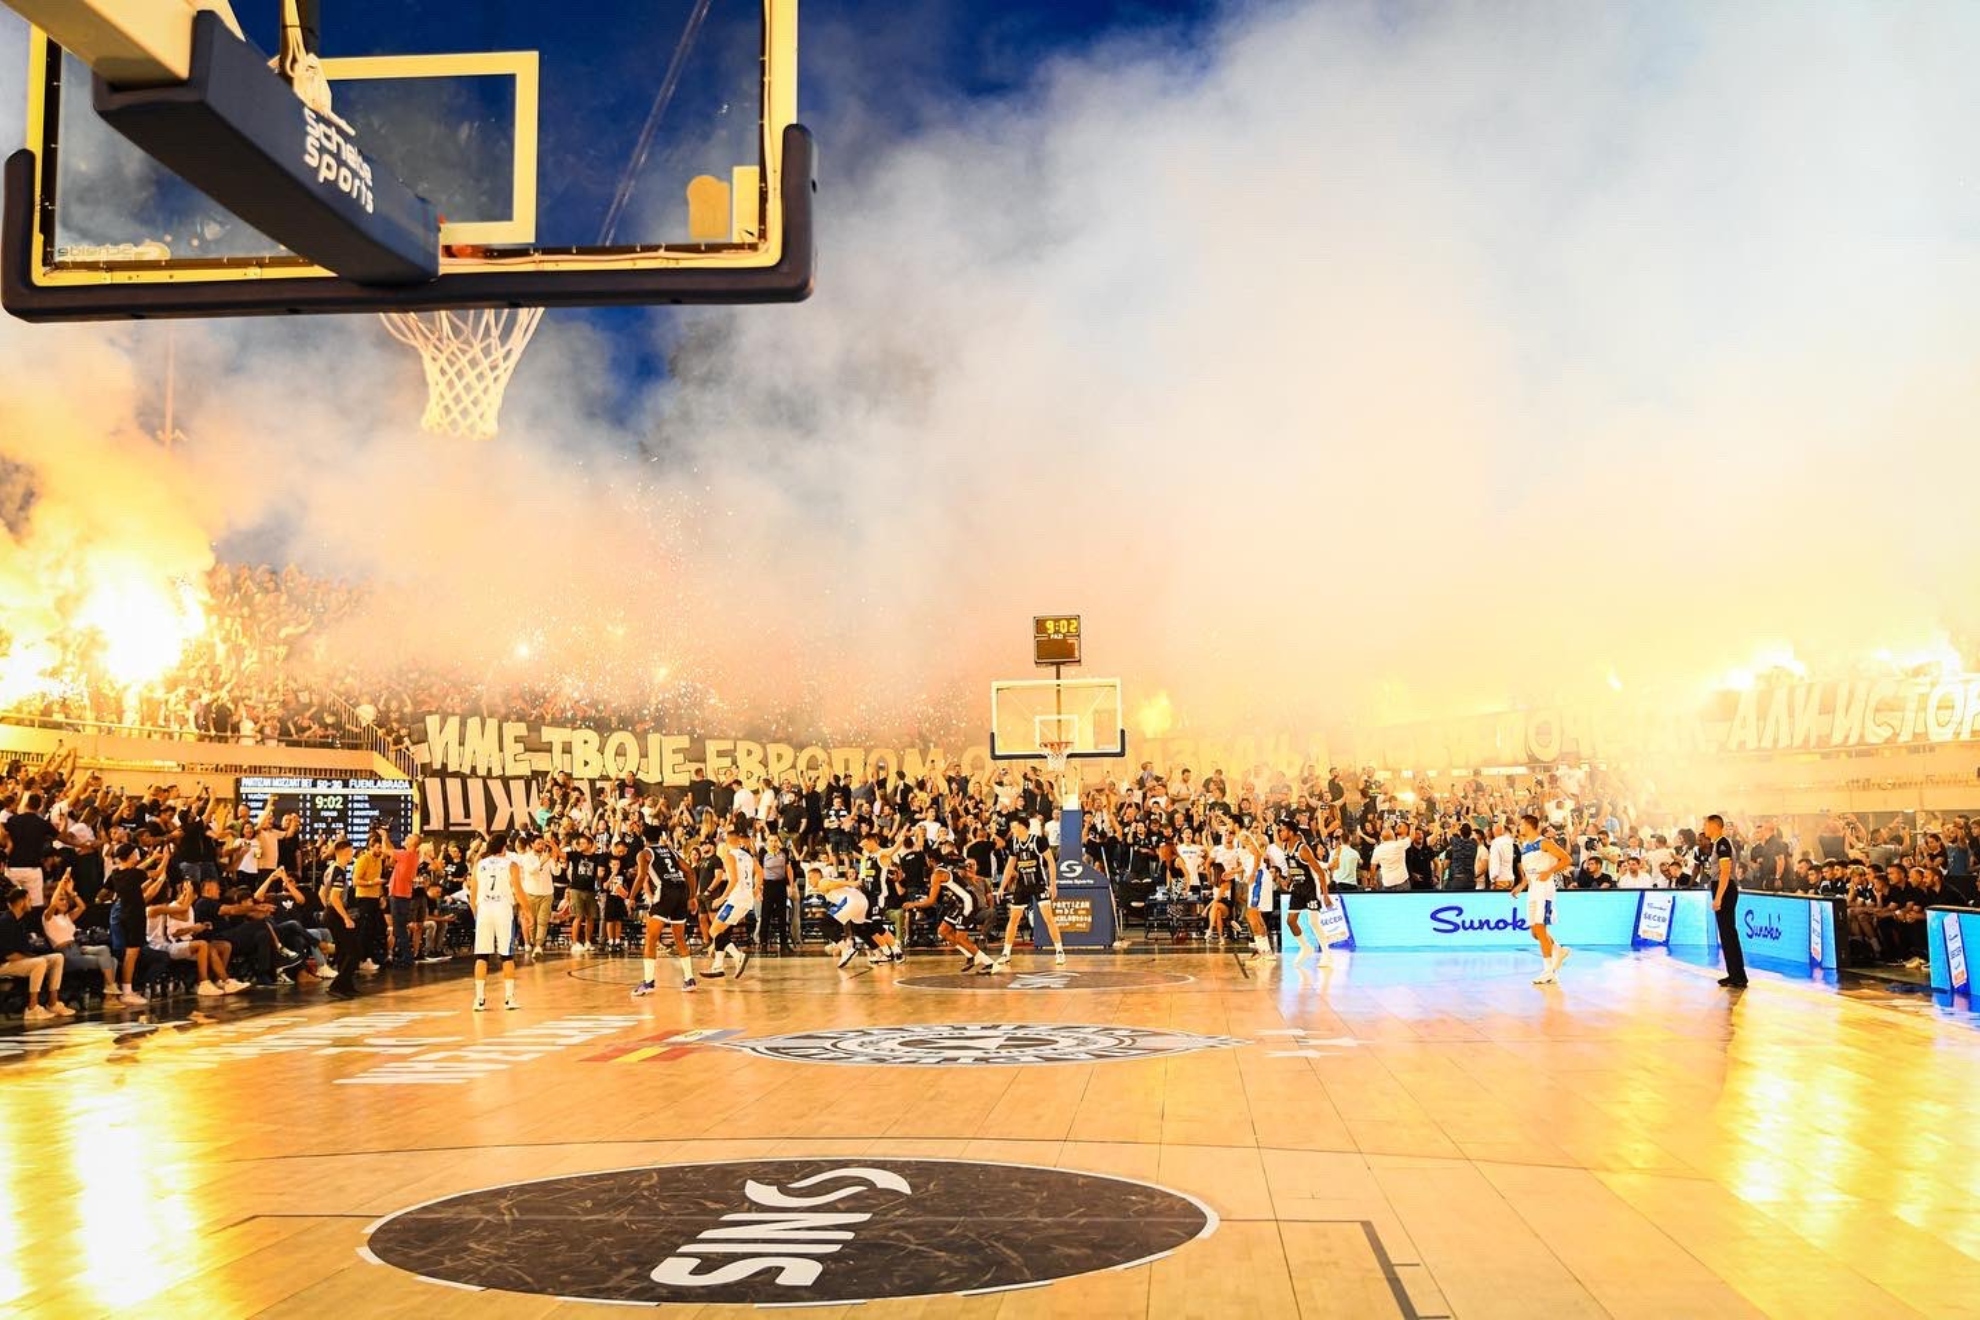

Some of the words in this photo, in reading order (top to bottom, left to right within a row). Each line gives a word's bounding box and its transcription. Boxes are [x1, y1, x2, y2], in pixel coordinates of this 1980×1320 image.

[1045, 620, 1078, 634] 9:02
[425, 714, 532, 777] ИМЕ
[316, 796, 343, 808] 9:02
[490, 875, 496, 891] 7
[1430, 906, 1530, 934] Sunok
